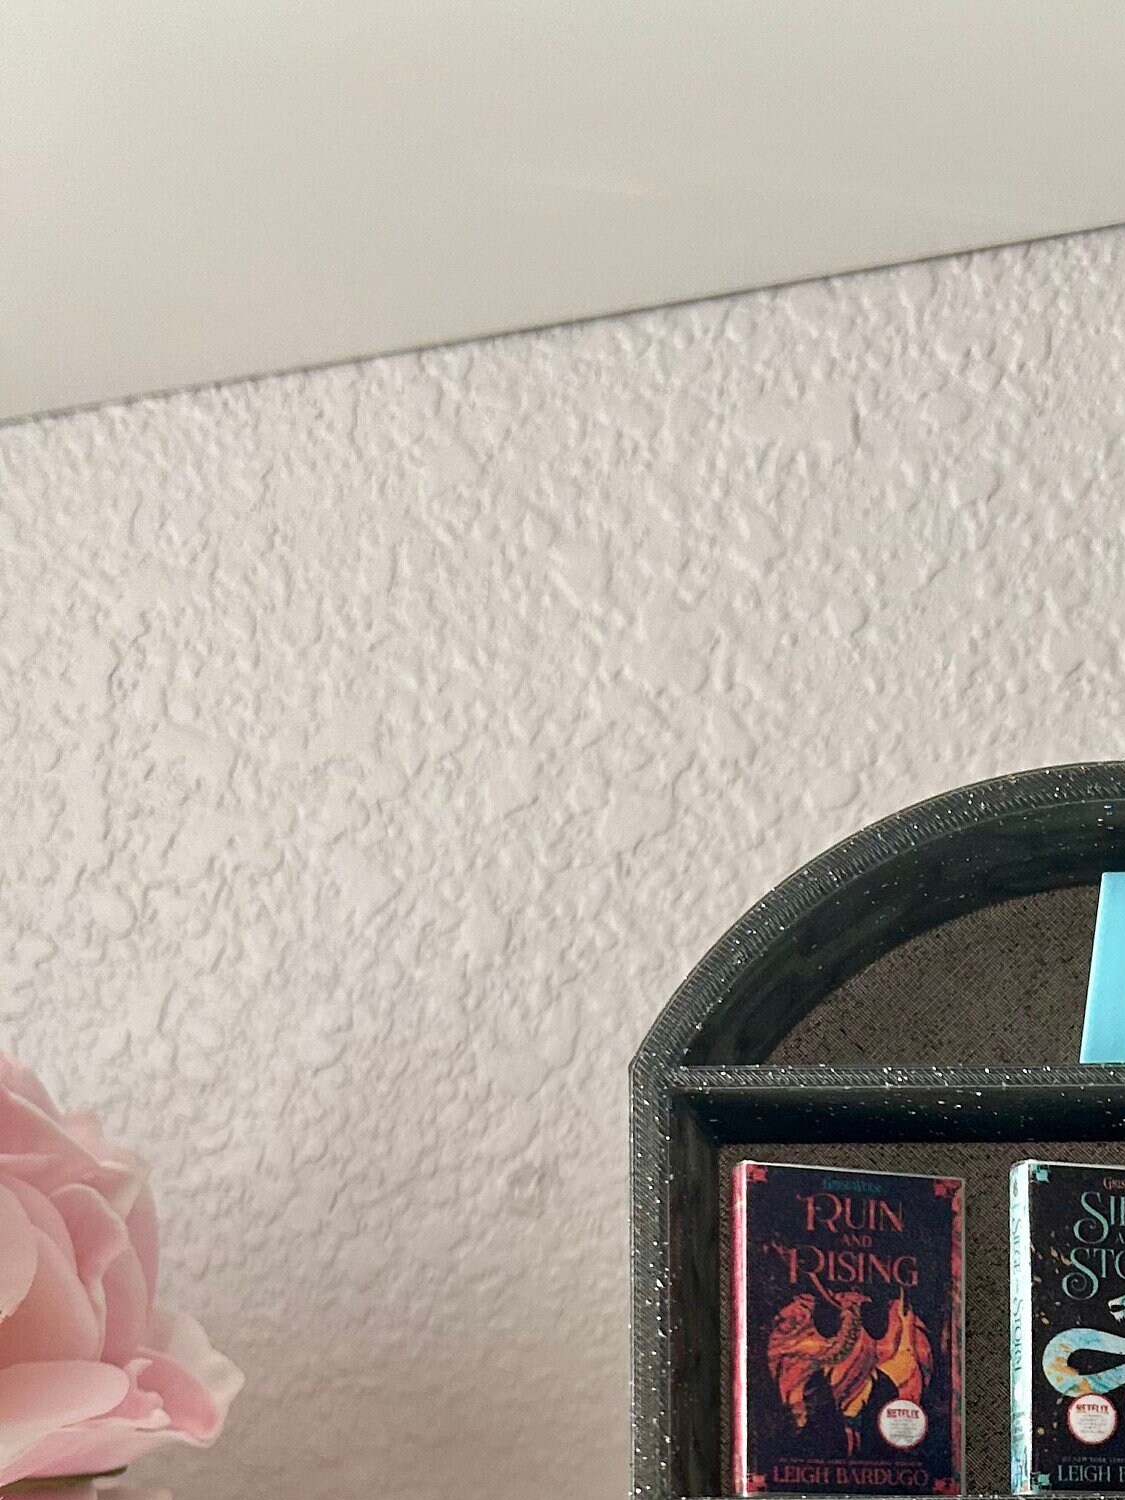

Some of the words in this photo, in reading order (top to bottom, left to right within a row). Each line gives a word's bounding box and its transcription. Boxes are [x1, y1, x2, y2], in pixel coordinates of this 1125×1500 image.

[796, 1192, 905, 1233] RUIN
[840, 1233, 873, 1248] AND
[766, 1244, 918, 1298] RISING
[773, 1465, 830, 1484] LEIGH
[836, 1466, 929, 1487] BARDUGO
[1058, 1464, 1111, 1483] LEIGH
